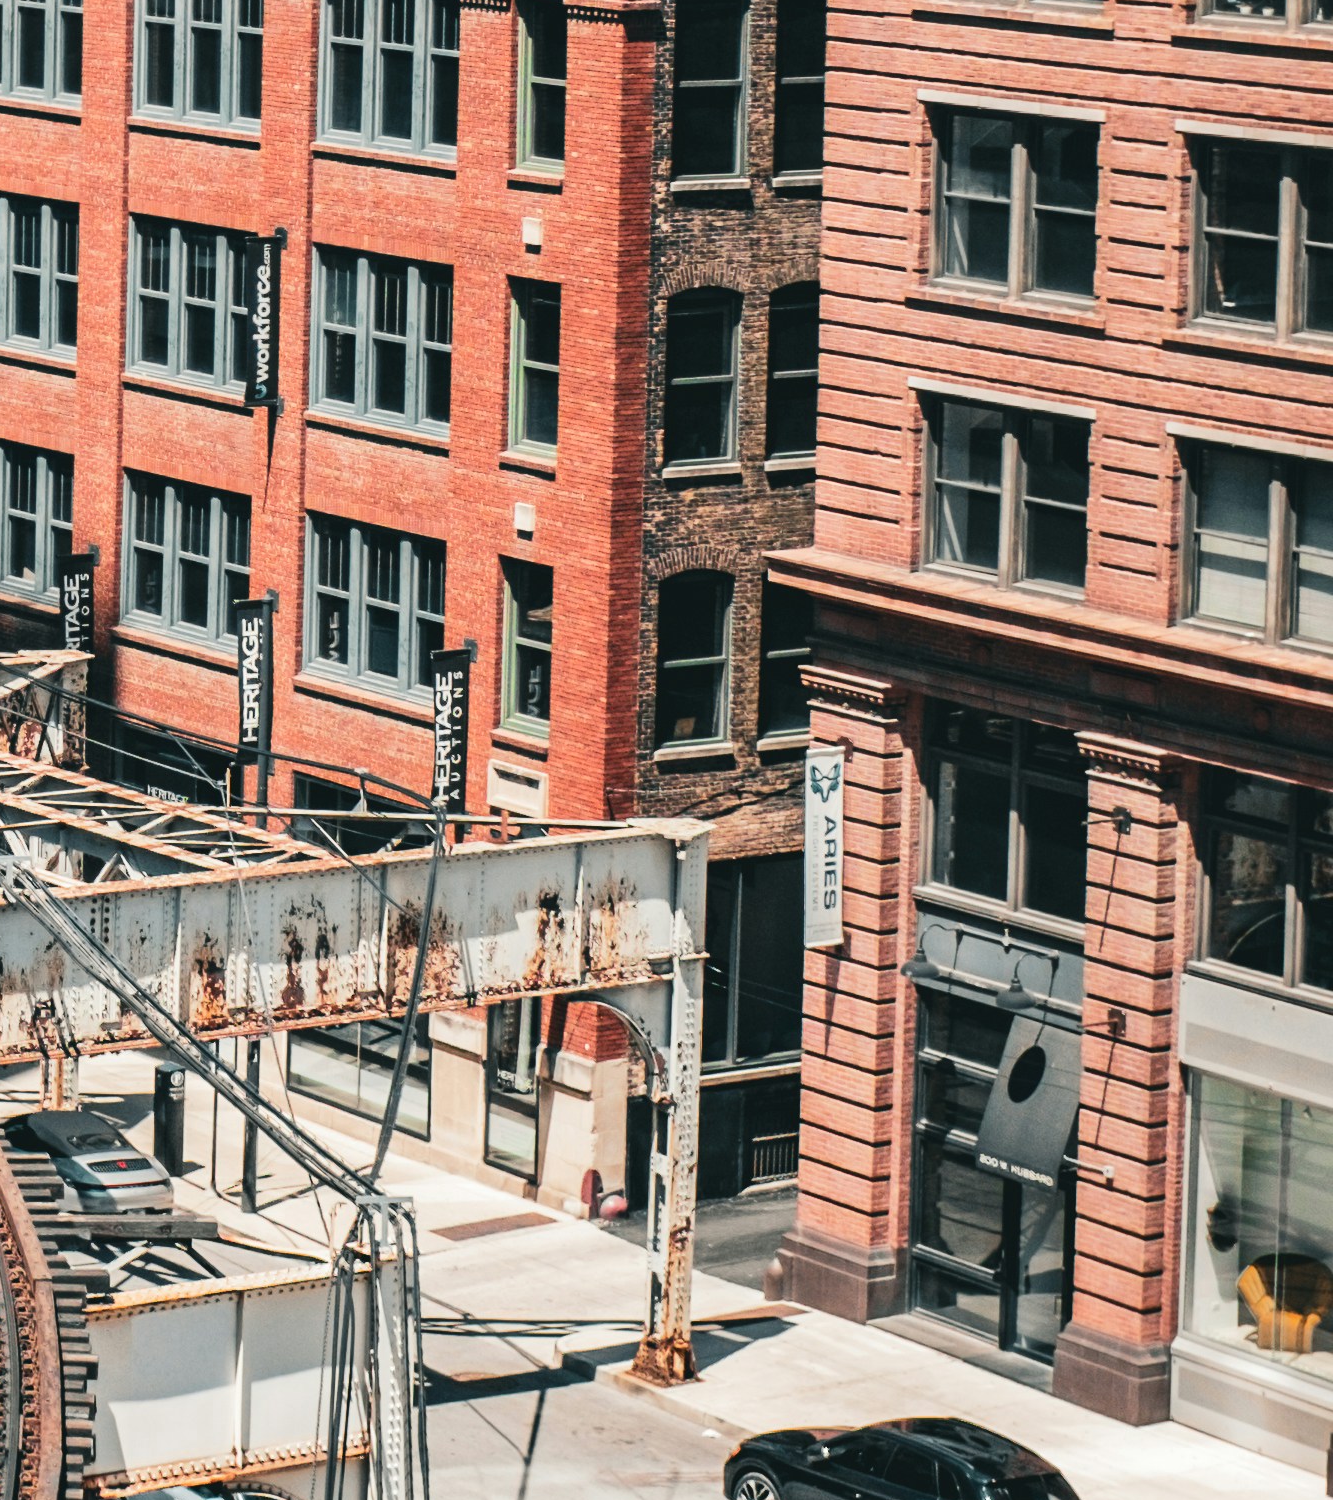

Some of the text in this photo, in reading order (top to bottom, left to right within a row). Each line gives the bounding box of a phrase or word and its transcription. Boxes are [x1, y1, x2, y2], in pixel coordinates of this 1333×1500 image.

[241, 617, 260, 743] HERITAGE
[433, 671, 453, 806] HERITAGE
[449, 670, 464, 801] AUCTIONS
[823, 815, 837, 911] ARIES
